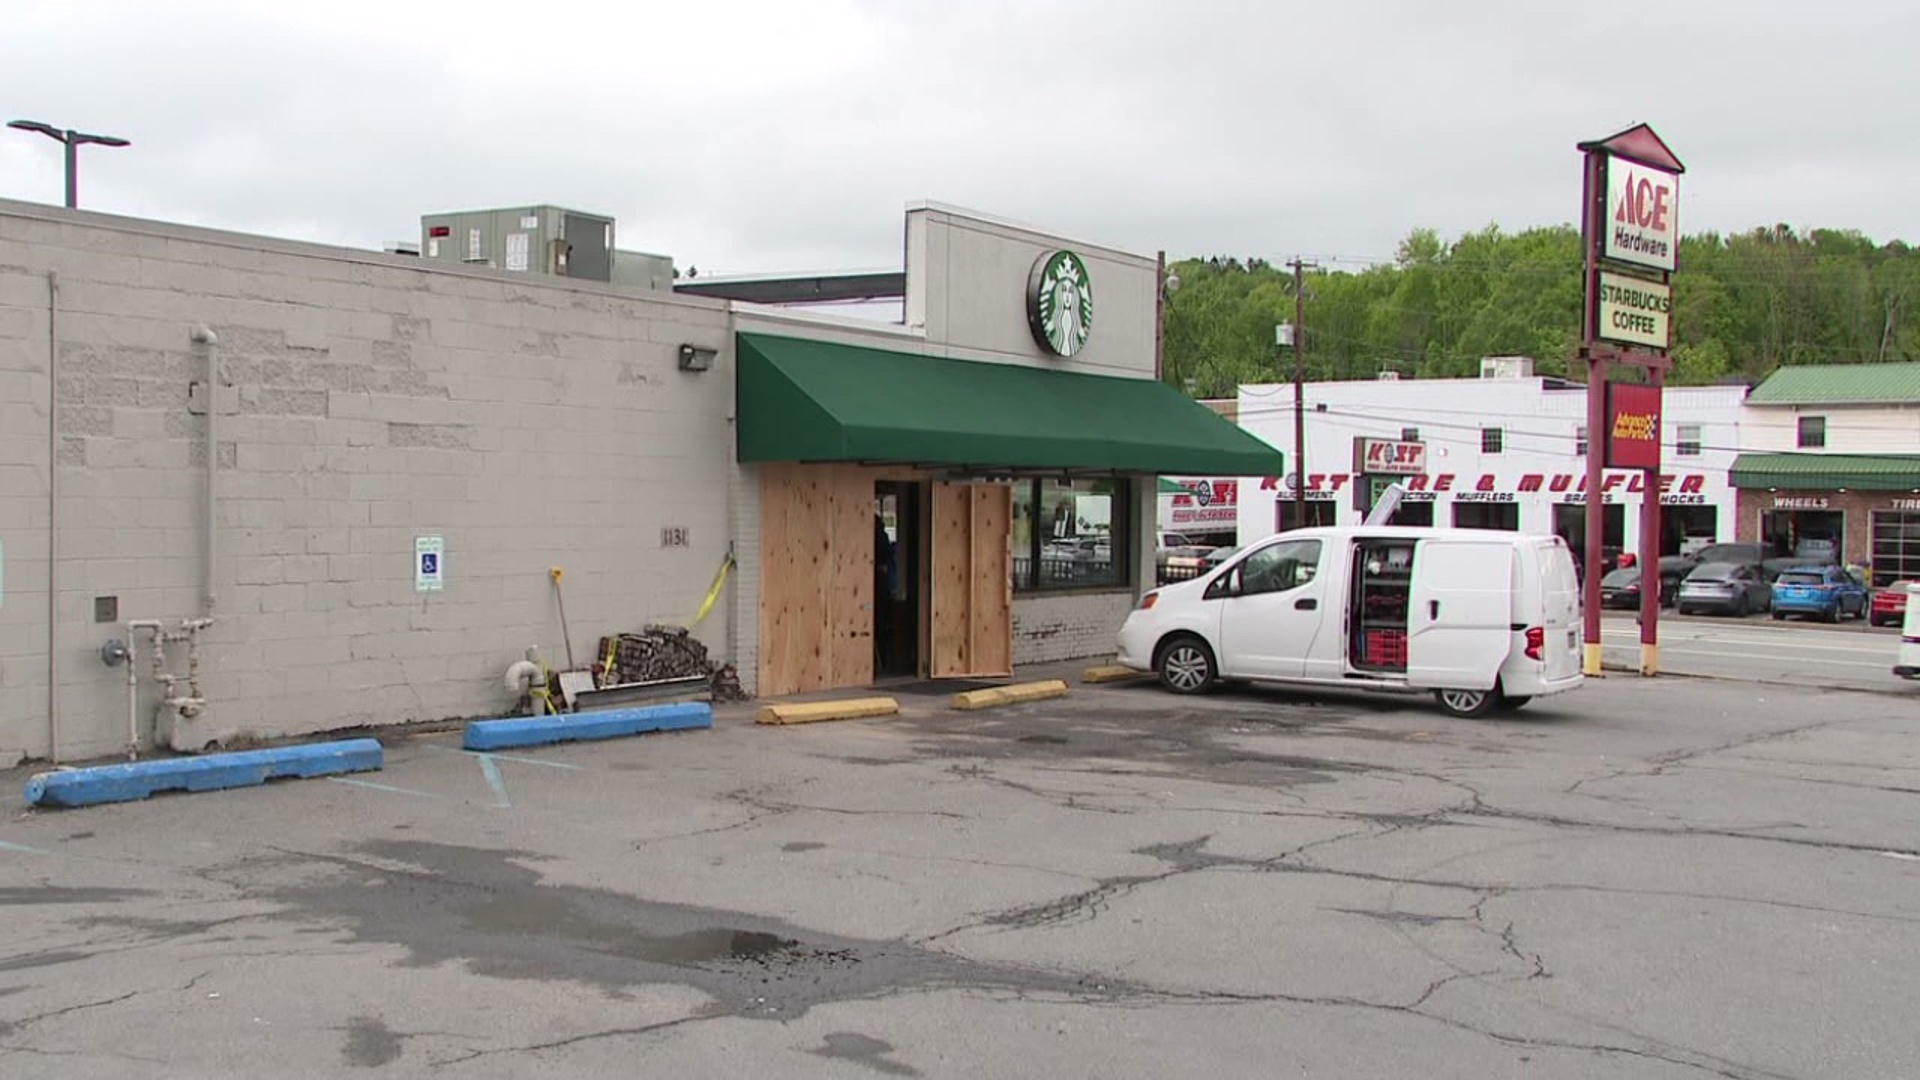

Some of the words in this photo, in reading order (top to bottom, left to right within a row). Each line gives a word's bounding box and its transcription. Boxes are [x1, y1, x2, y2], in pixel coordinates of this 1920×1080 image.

[1615, 168, 1669, 232] ACE
[1614, 226, 1668, 257] Hardware
[1601, 284, 1669, 314] STARBUCKS
[1612, 311, 1655, 335] COFFEE
[1476, 474, 1495, 491] &
[1455, 492, 1515, 501] MUFFLERS
[1660, 494, 1705, 503] HOCKS
[1774, 498, 1828, 508] WHEELS
